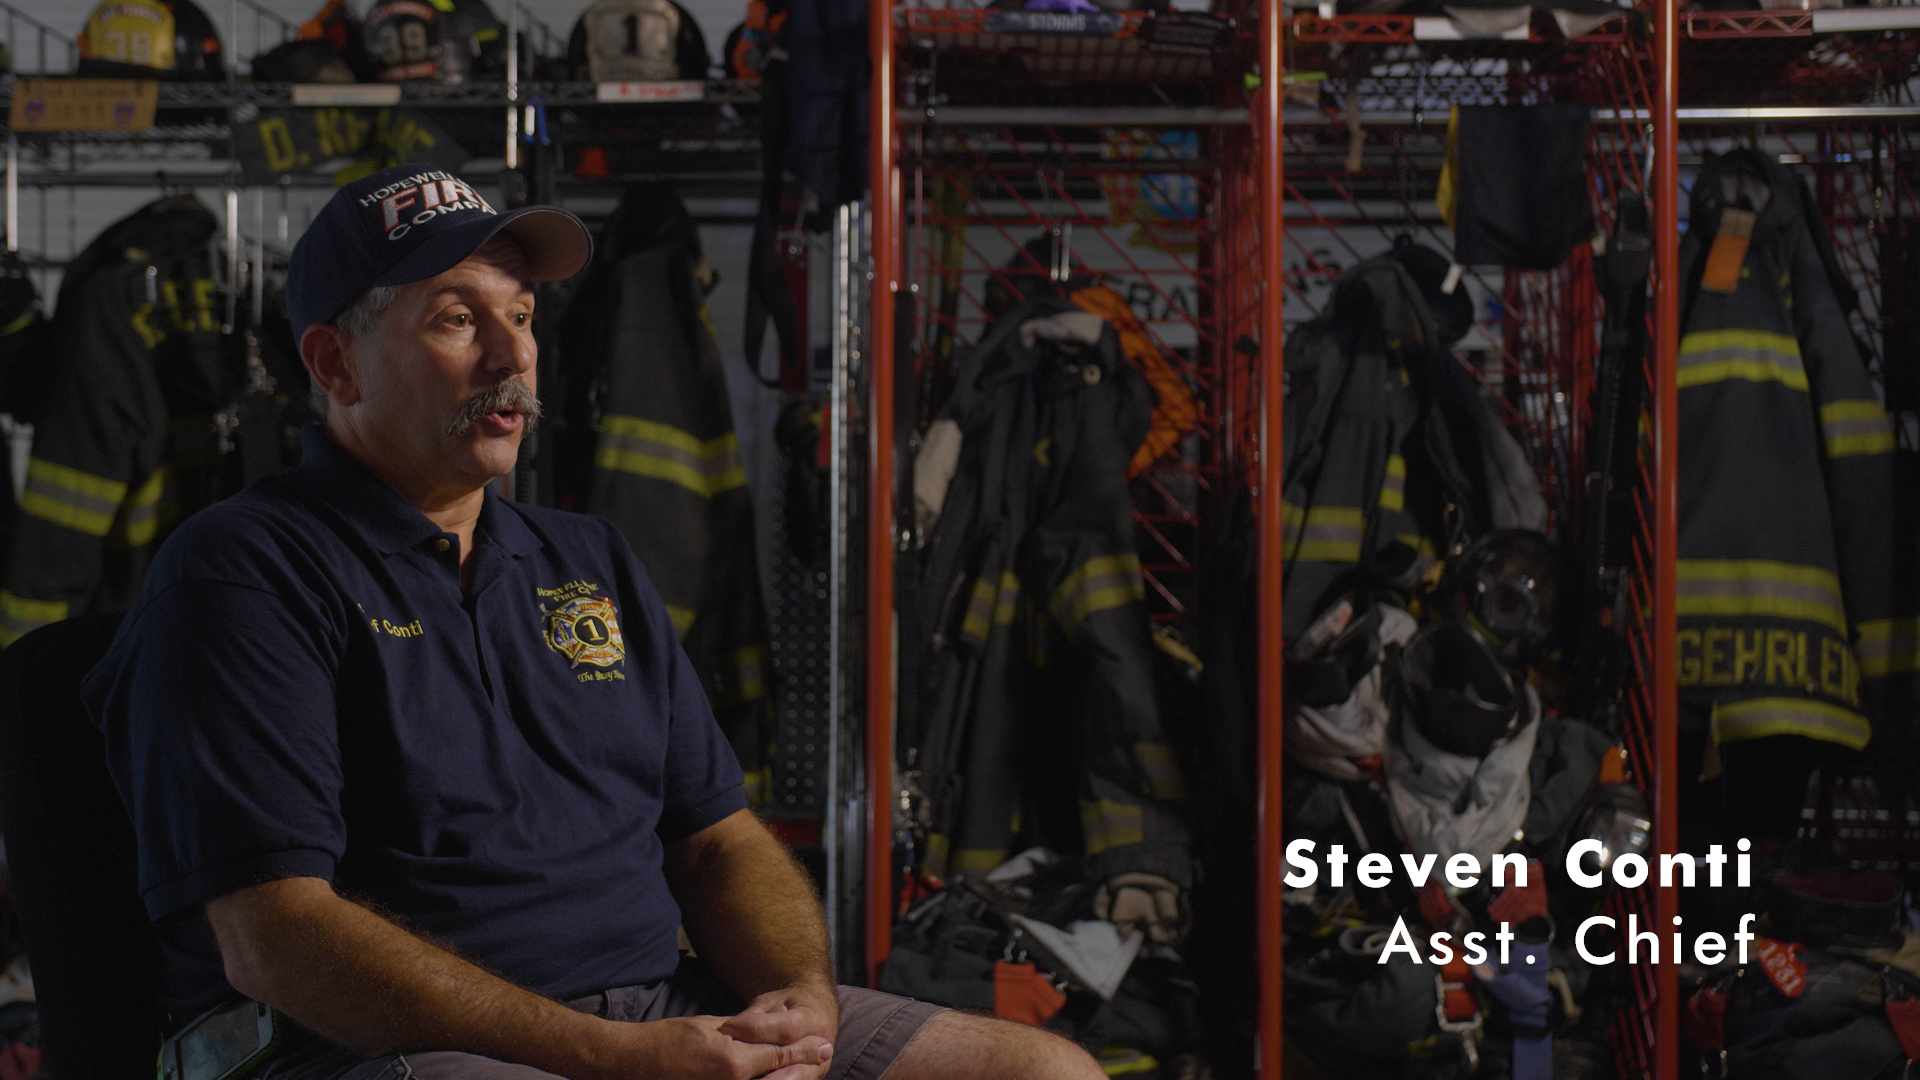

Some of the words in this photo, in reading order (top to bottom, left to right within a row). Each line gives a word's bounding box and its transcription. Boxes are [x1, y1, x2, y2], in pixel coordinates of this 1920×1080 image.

[106, 31, 152, 66] 39
[622, 14, 638, 55] 1
[382, 619, 424, 638] Conti
[582, 618, 604, 641] 1
